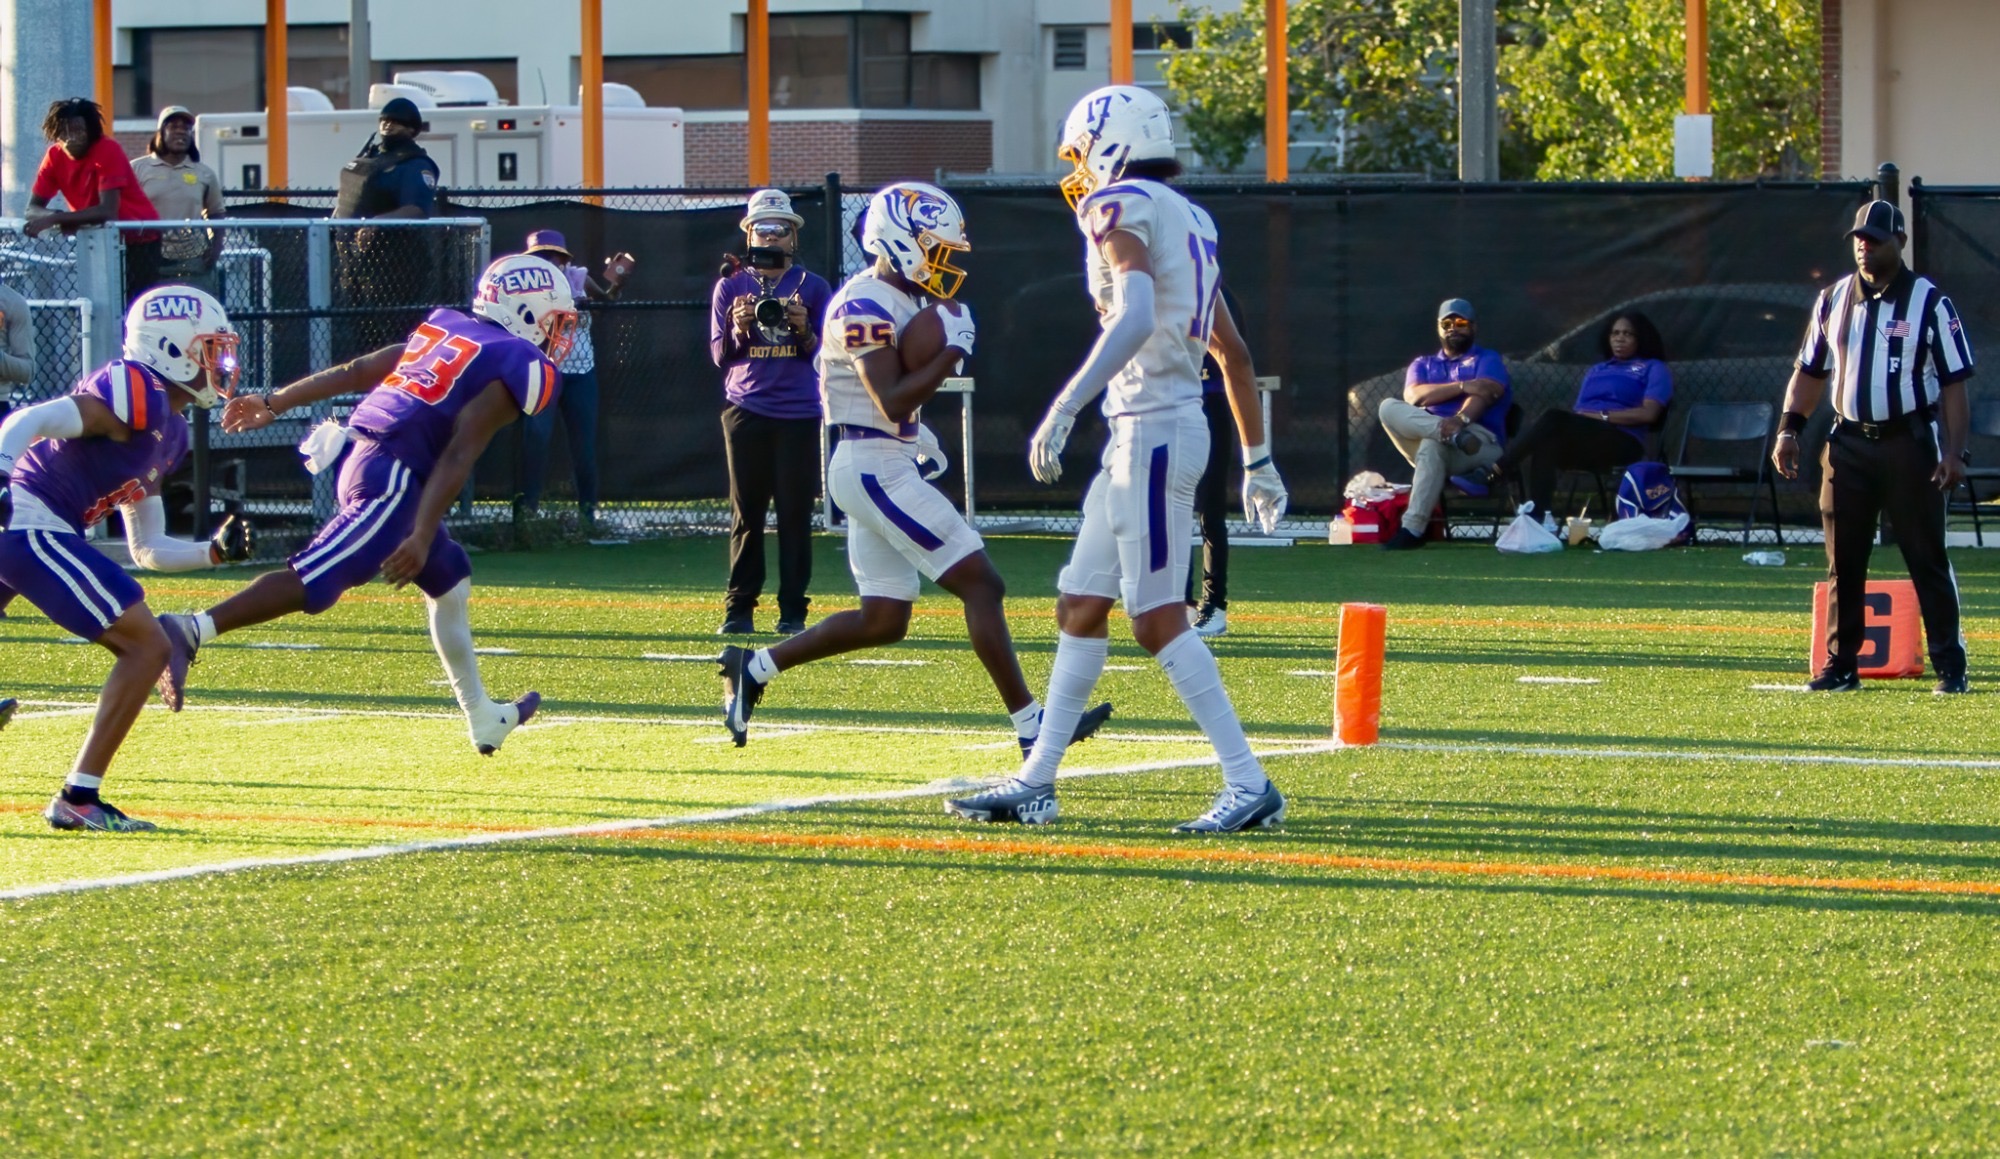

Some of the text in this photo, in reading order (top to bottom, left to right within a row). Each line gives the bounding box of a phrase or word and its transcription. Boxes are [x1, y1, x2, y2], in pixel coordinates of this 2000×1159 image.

[1087, 95, 1112, 124] 17
[503, 267, 554, 295] EWU
[1187, 231, 1223, 342] 17
[144, 295, 201, 320] EWU
[844, 322, 896, 349] 25
[381, 322, 482, 405] 23
[1889, 356, 1900, 373] F
